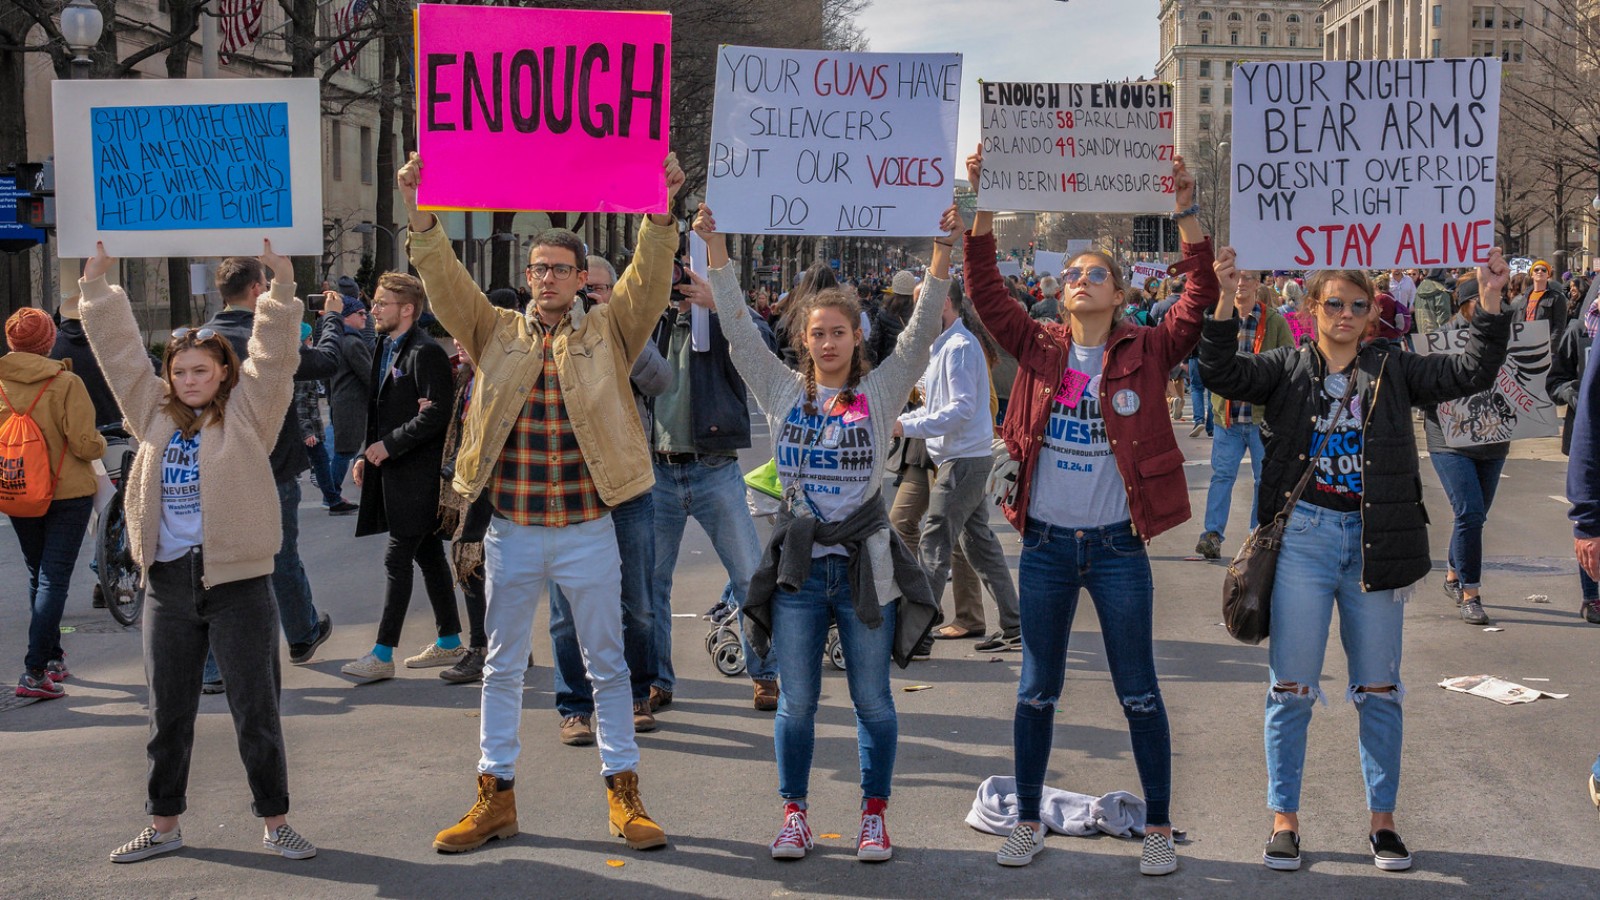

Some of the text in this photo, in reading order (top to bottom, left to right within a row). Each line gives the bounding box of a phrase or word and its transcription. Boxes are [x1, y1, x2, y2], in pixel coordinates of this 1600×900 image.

[427, 42, 665, 141] ENOUGH
[724, 53, 958, 101] YOUR GUNS HAVE
[1240, 58, 1486, 105] YOUR RIGHT TO
[983, 83, 1172, 109] ENOUGH IS ENOUGH
[750, 107, 892, 140] SILENCERS
[983, 109, 1172, 130] LAS VEGAS 58 PARKLAND 17
[1265, 101, 1486, 154] BEAR ARMS
[101, 135, 269, 173] AN AMENDMENT
[713, 143, 944, 188] BUT OUR VOICES
[983, 137, 1174, 162] ORLANDO 49 SANDY HOOK 27
[100, 160, 284, 199] MADE WHEN GUNS
[982, 169, 1175, 193] SAN BERN 14 BLACKSBURG 32
[1237, 156, 1494, 192] DOESN'T OVERRIDE
[101, 194, 166, 225] HELD
[171, 192, 213, 221] ONE
[770, 194, 896, 229] DO NOT
[1258, 185, 1476, 221] MY RIGHT TO
[1294, 220, 1491, 267] STAY ALIVE
[1134, 265, 1166, 279] PROTECT KIDS
[1426, 323, 1524, 352] RIS P
[1497, 367, 1533, 413] JUSTICE
[1044, 417, 1091, 445] IVES
[163, 448, 190, 466] OR
[779, 446, 838, 469] LIVES
[1057, 460, 1092, 472] 03.24.18
[161, 465, 199, 483] IVES
[805, 484, 840, 494] 03.24.18
